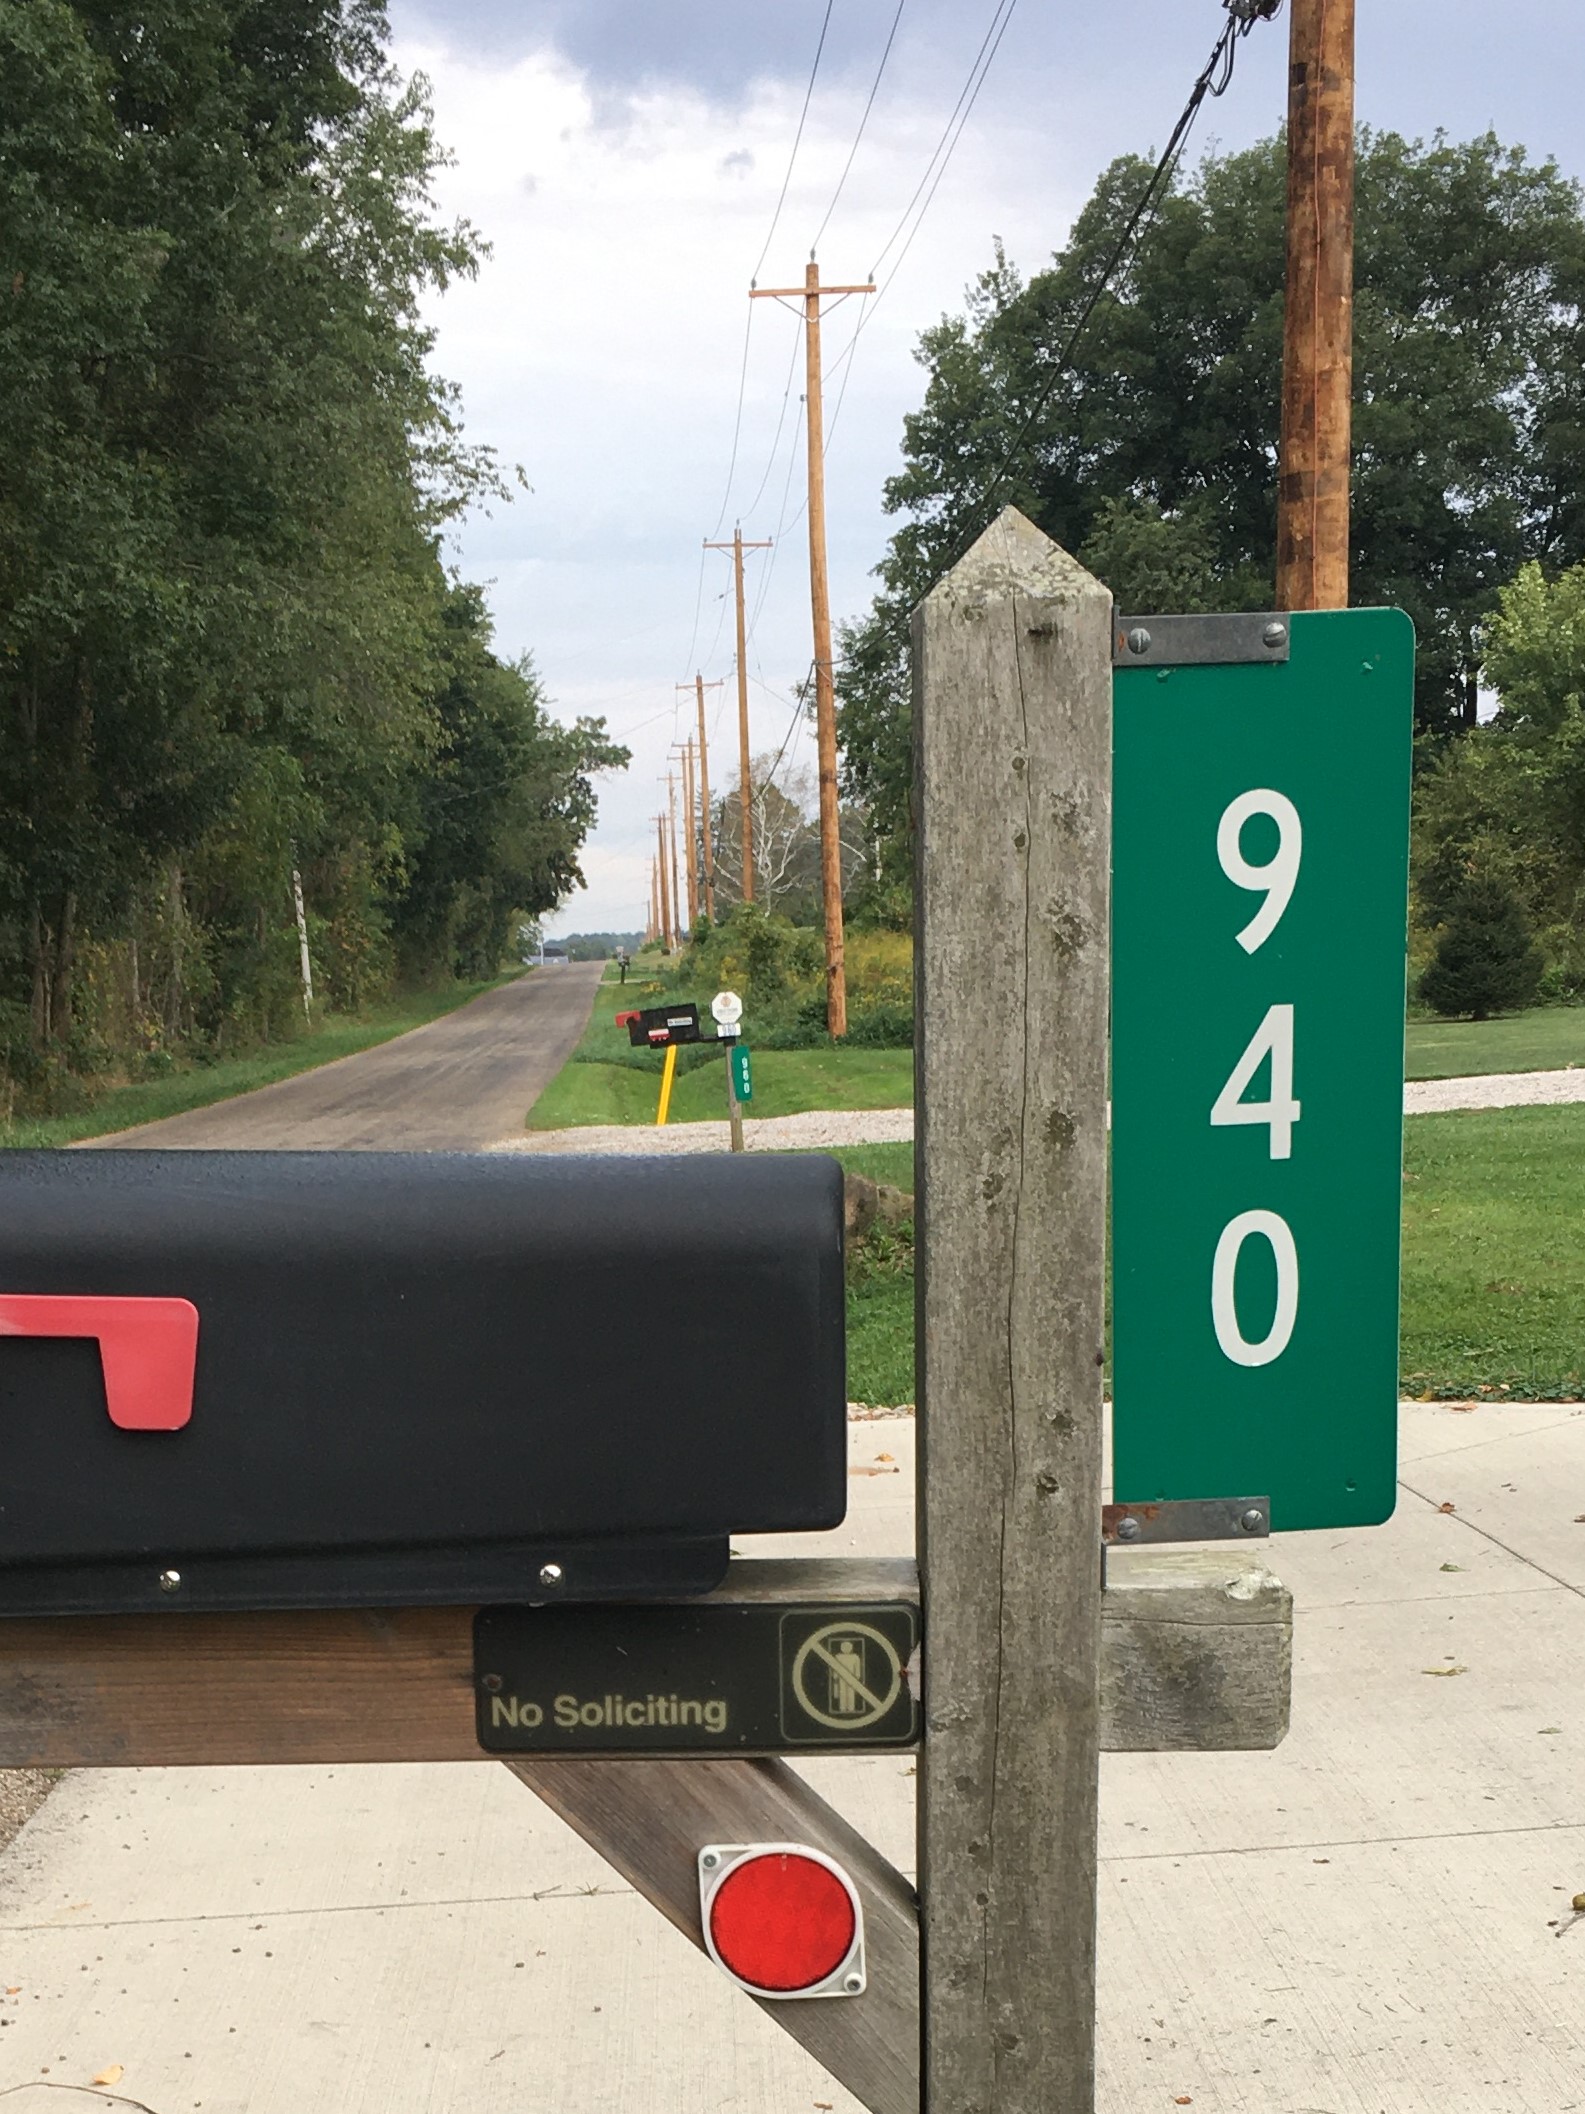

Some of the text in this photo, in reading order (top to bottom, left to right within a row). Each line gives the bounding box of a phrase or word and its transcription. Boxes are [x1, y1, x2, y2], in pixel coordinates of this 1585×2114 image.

[1210, 788, 1302, 1367] 940
[492, 1694, 727, 1733] No Soliciting
